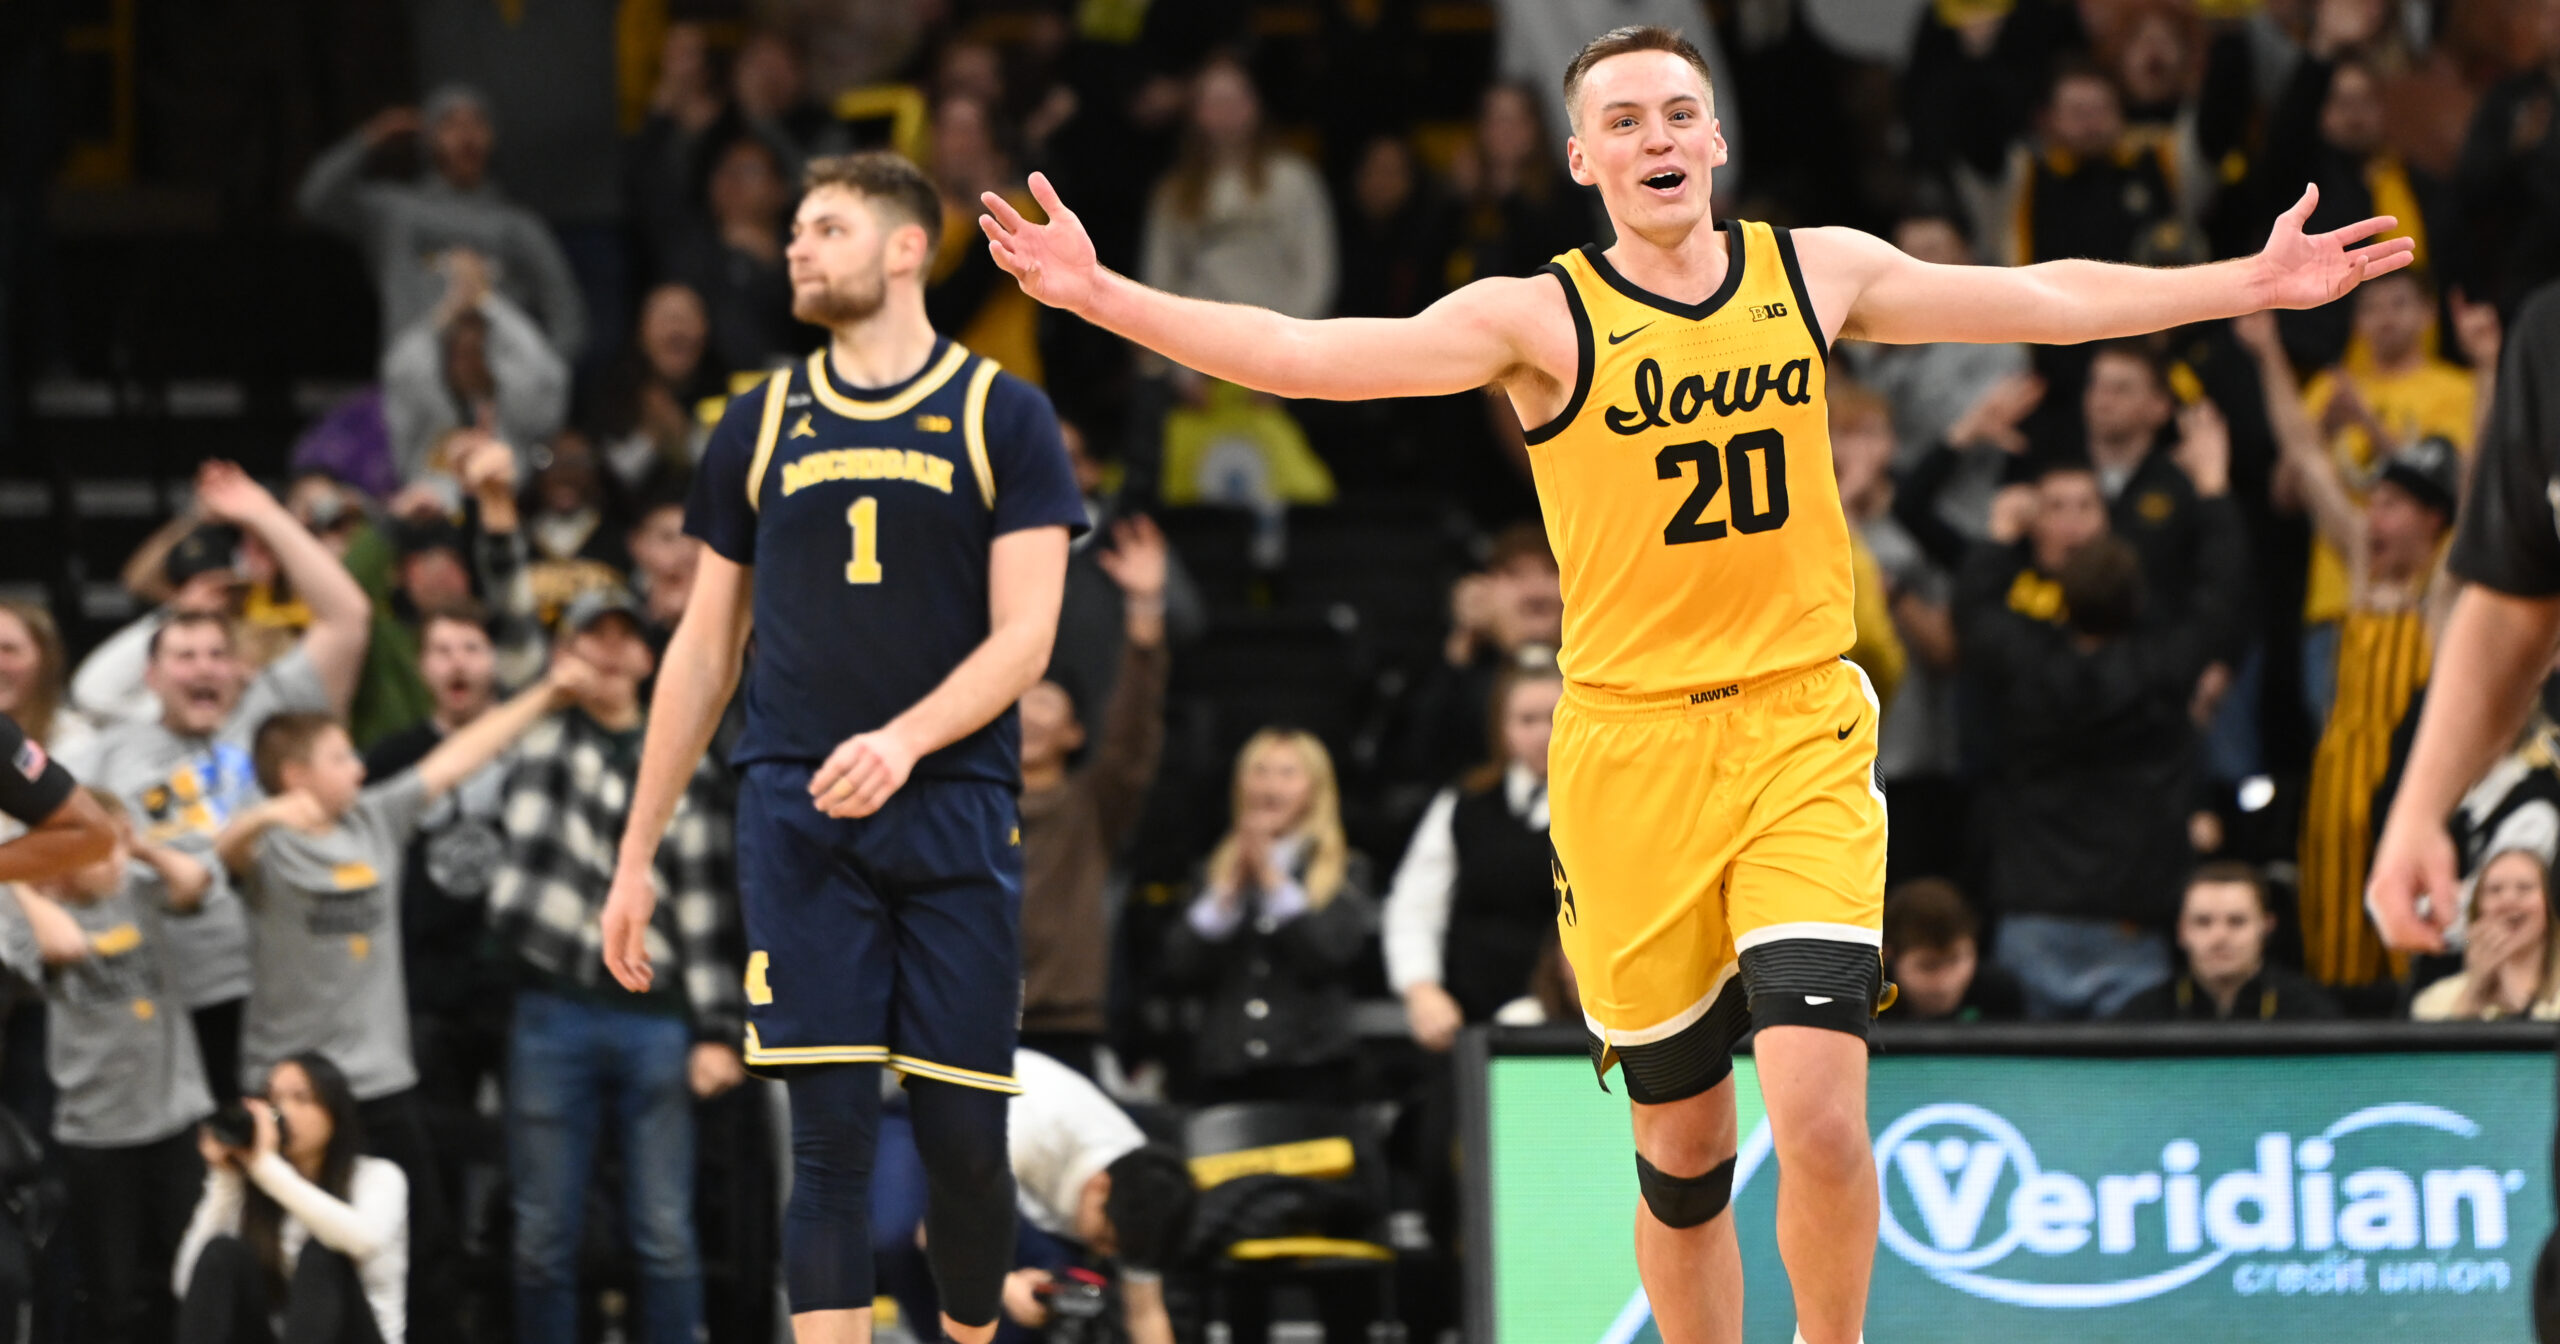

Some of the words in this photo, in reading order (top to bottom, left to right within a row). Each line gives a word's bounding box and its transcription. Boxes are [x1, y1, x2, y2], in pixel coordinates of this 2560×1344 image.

[1604, 358, 1811, 436] Iowa
[1655, 427, 1790, 546] 20
[845, 496, 883, 584] 1
[1689, 683, 1740, 705] HAWKS
[1895, 1131, 2509, 1255] Veridian
[2231, 1254, 2367, 1295] credit
[2378, 1252, 2511, 1295] union
